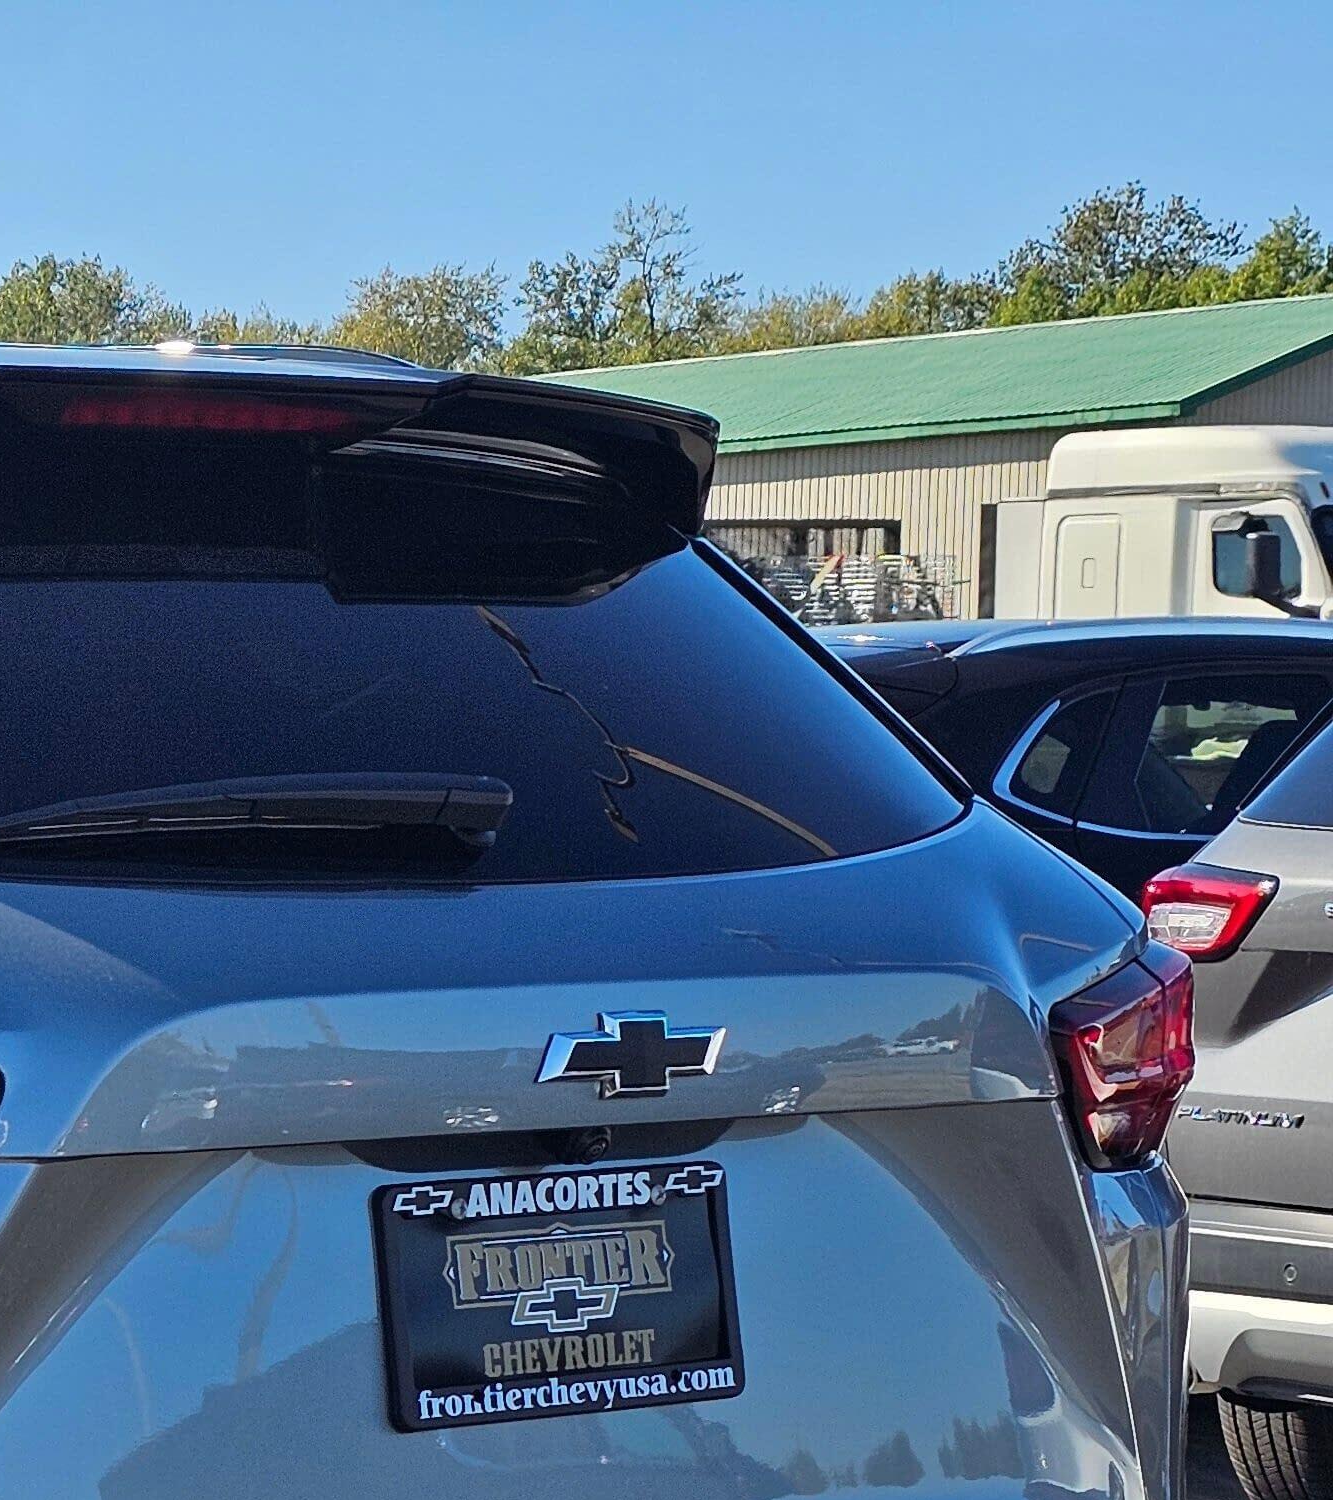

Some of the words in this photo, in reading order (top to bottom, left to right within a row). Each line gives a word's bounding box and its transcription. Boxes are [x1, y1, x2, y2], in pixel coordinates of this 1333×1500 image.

[1176, 1105, 1305, 1129] PLATINUM
[465, 1171, 652, 1218] ANACORTES
[454, 1229, 666, 1301] FRONTIER
[482, 1329, 655, 1378] CHEVROLET
